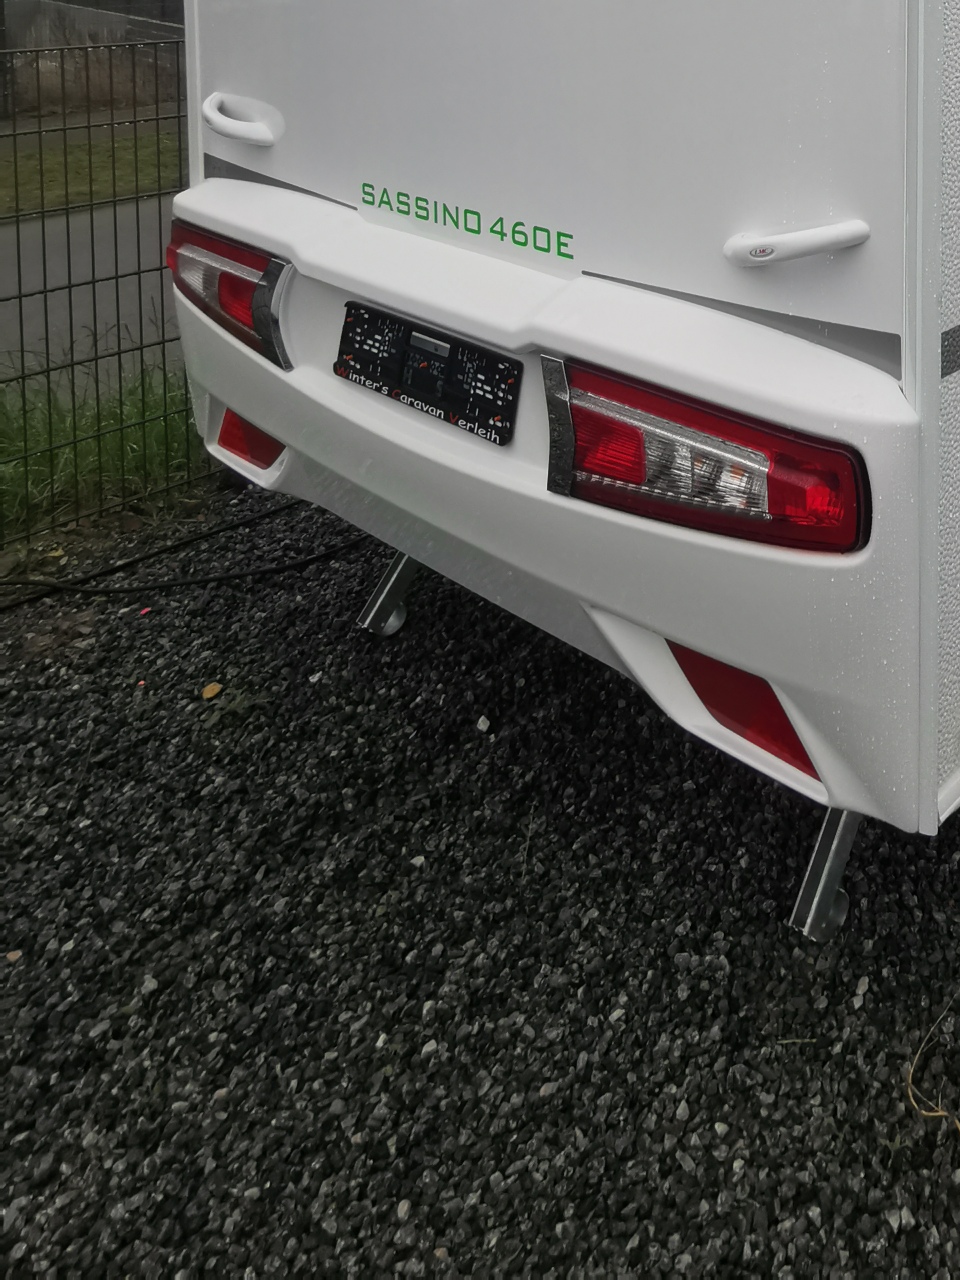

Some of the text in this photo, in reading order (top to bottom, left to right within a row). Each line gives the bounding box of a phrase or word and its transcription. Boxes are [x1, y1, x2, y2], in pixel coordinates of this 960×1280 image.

[361, 182, 574, 260] SASSINO 460E
[335, 365, 501, 444] Winter's Caravan Verleih
